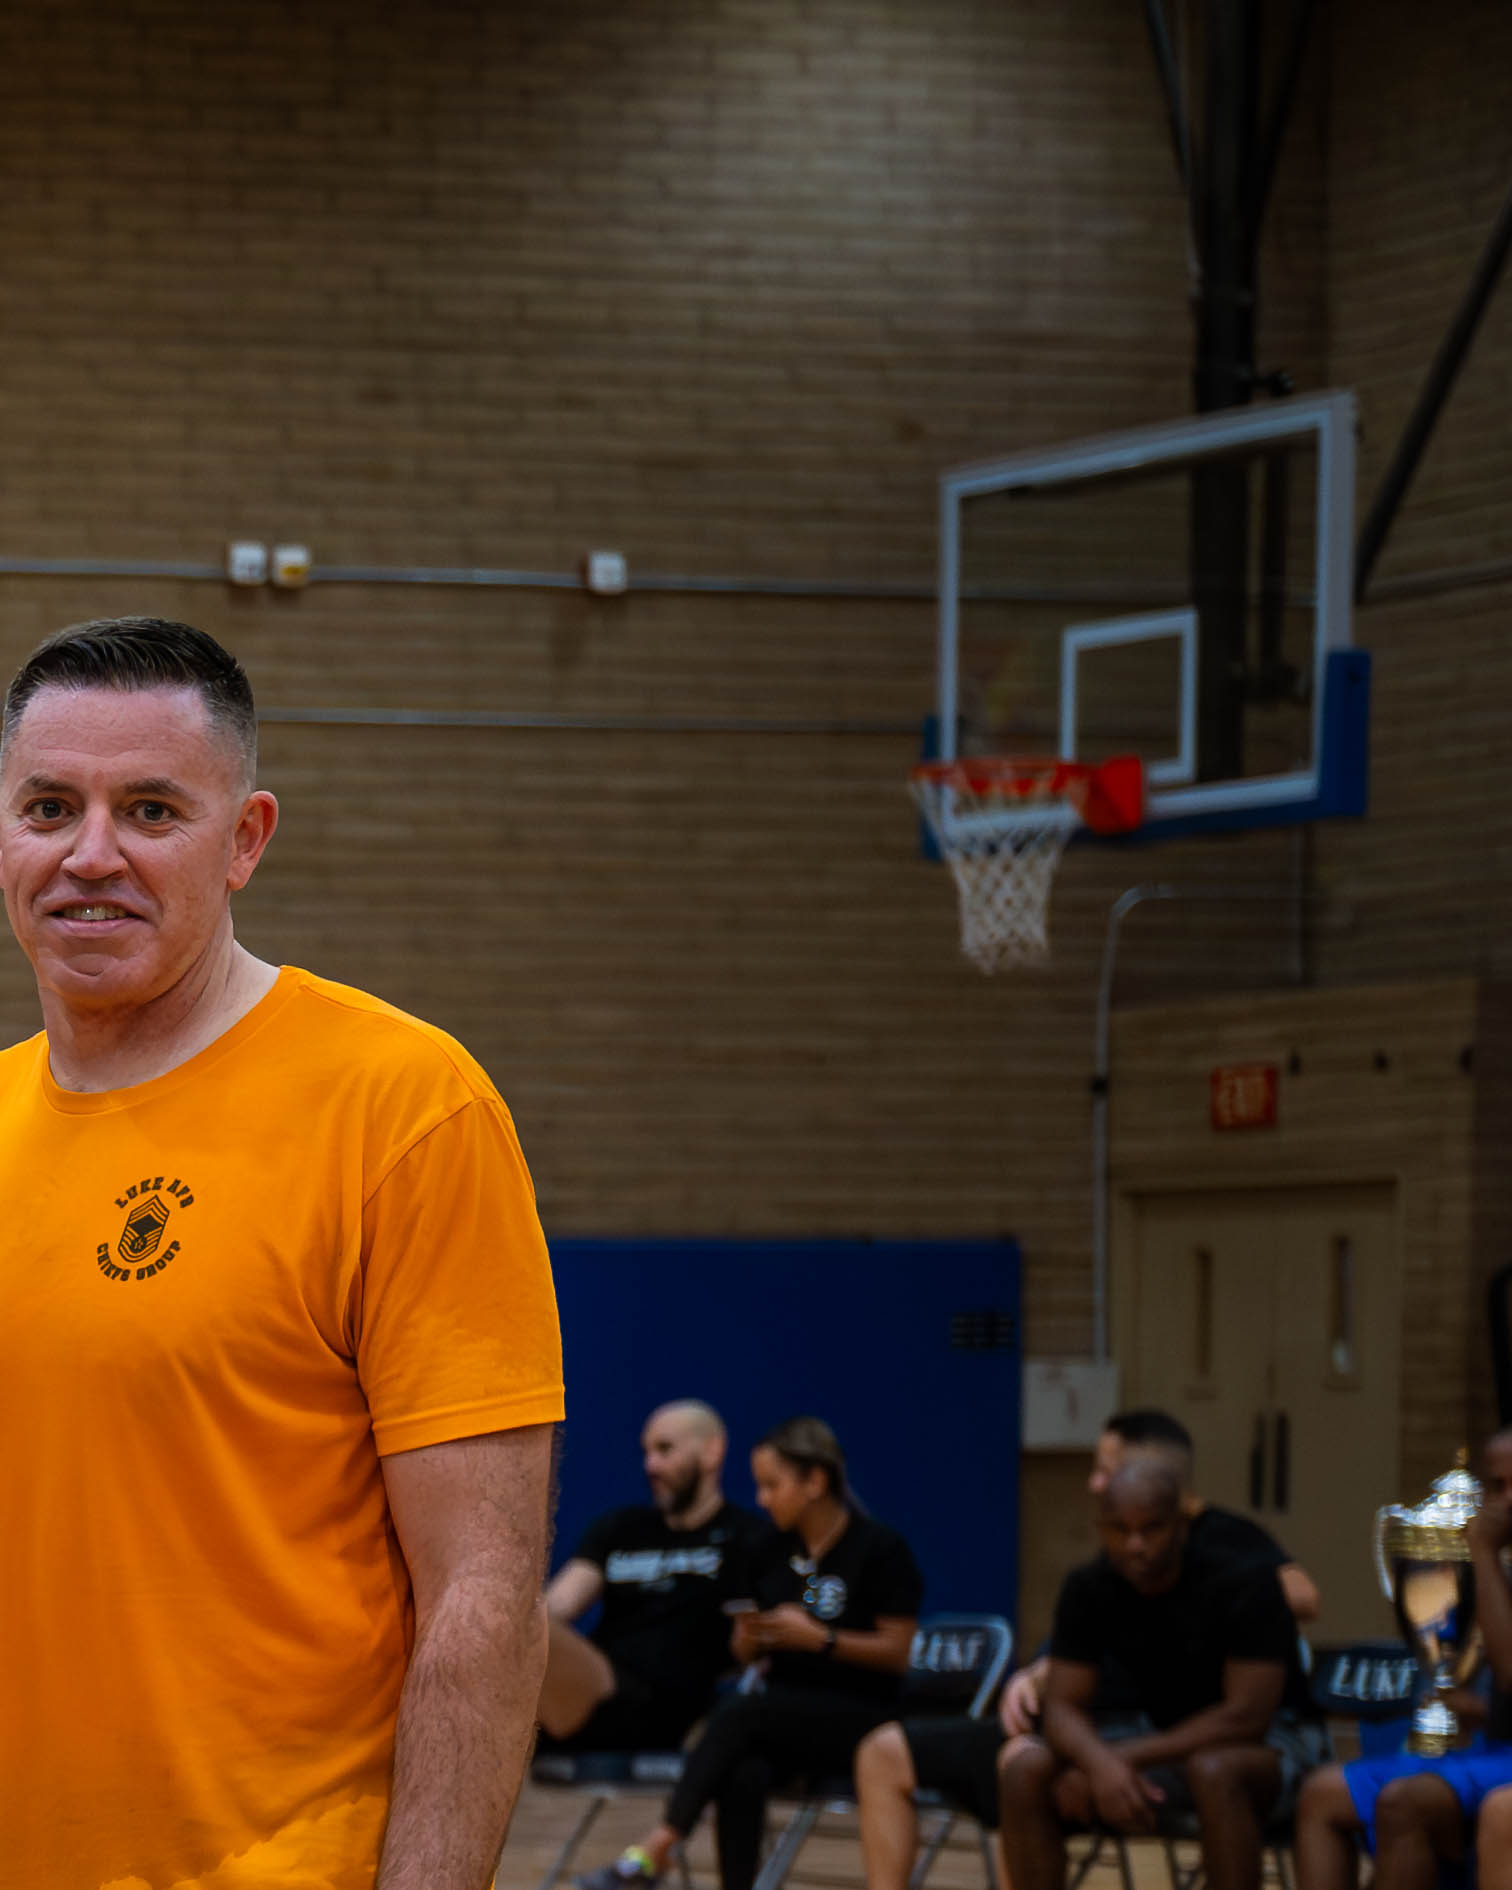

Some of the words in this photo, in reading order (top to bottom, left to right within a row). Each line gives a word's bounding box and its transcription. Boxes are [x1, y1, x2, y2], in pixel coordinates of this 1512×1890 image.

[114, 1176, 165, 1209] LUKE
[166, 1178, 195, 1209] AFB
[96, 1242, 131, 1282] CHIEFS
[136, 1240, 182, 1281] GROUP
